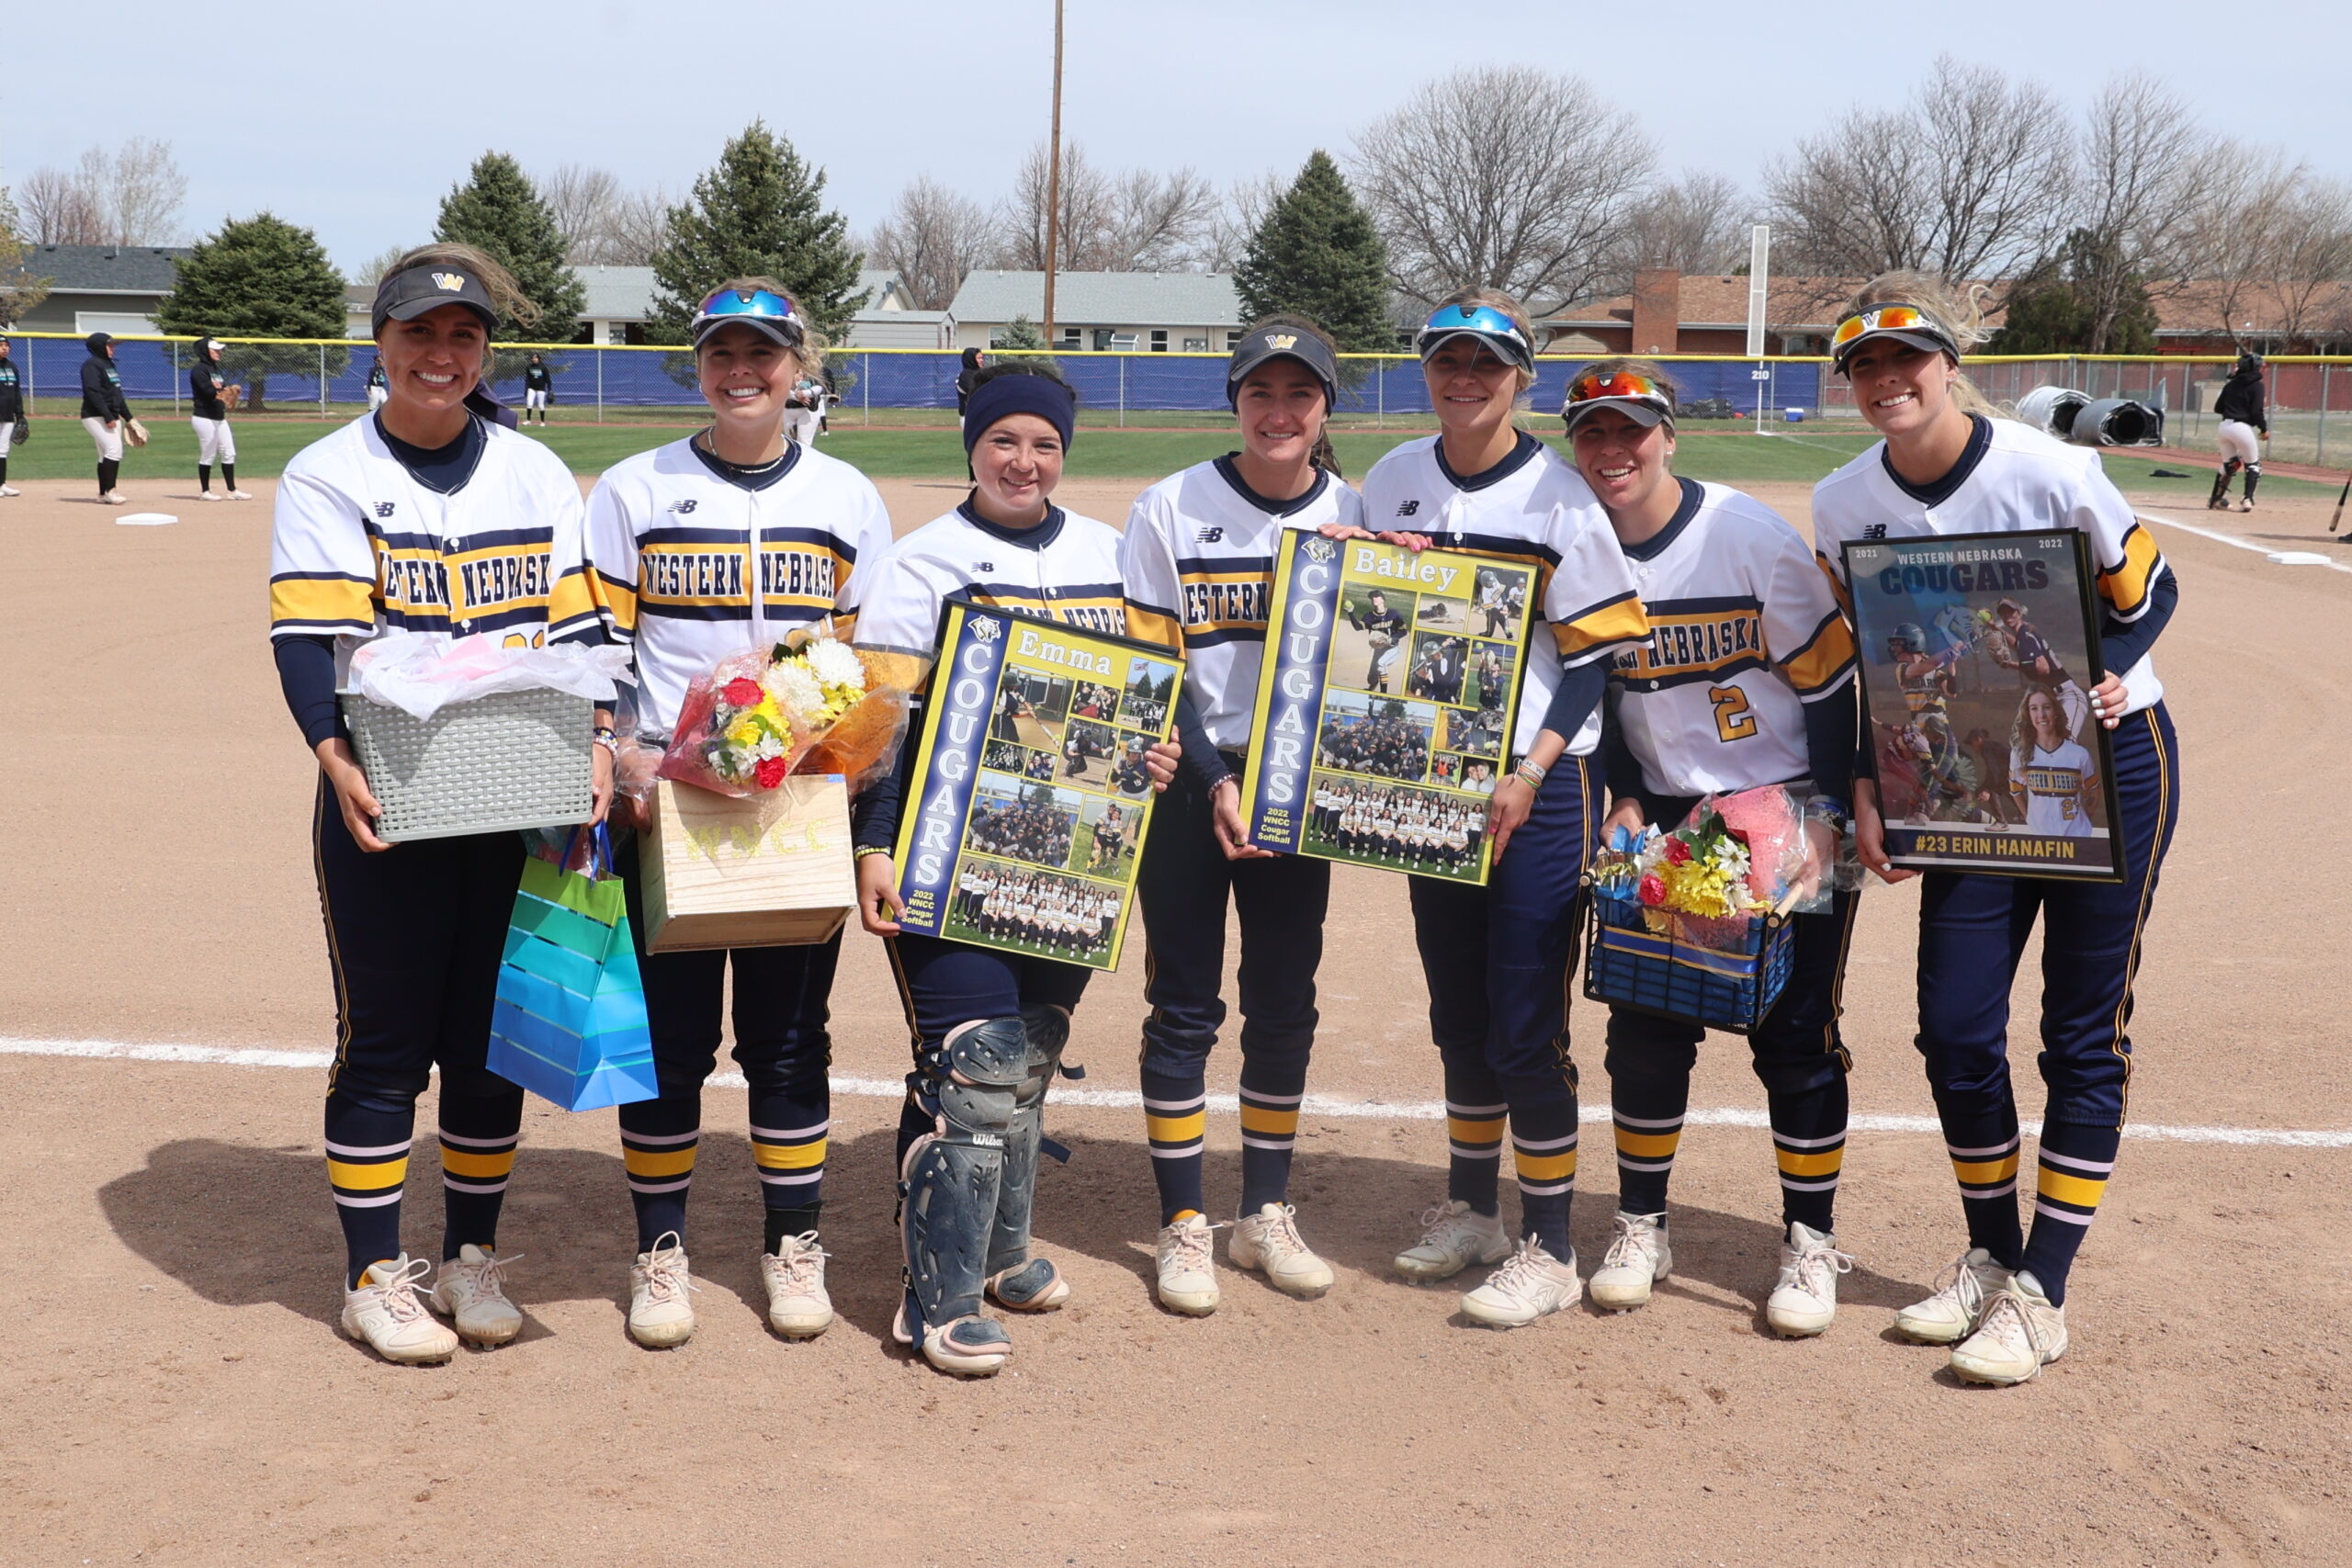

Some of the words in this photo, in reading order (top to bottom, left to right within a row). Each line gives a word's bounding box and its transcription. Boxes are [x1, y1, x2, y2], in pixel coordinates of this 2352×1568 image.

[1751, 370, 1770, 379] 210
[1855, 548, 1879, 558] 2021
[2038, 538, 2064, 549] 2022
[1897, 550, 1955, 566] WESTERN
[1957, 547, 2023, 563] NEBRASKA
[641, 553, 743, 597] WESTERN
[1353, 547, 1459, 592] Bailey
[1880, 559, 2050, 595] COUGARS
[460, 553, 551, 609] NEBRASK
[1183, 581, 1269, 626] ESTERN
[1647, 616, 1762, 669] NEBRASKA
[1017, 629, 1112, 677] Emma
[1268, 564, 1329, 803] COUGARS
[1708, 683, 1758, 743] 2
[914, 643, 992, 886] COUGARS
[1263, 815, 1291, 826] WNCC
[1267, 807, 1290, 818] 2022
[1257, 832, 1291, 844] Softball
[1261, 824, 1291, 836] Cougar
[1916, 835, 1947, 852] #23
[1952, 837, 1991, 855] ERIN
[1996, 839, 2075, 859] HANAFIN
[909, 897, 935, 909] WNCC
[912, 889, 934, 900] 2022
[906, 907, 934, 919] Cougar
[972, 1134, 1003, 1146] Wilson
